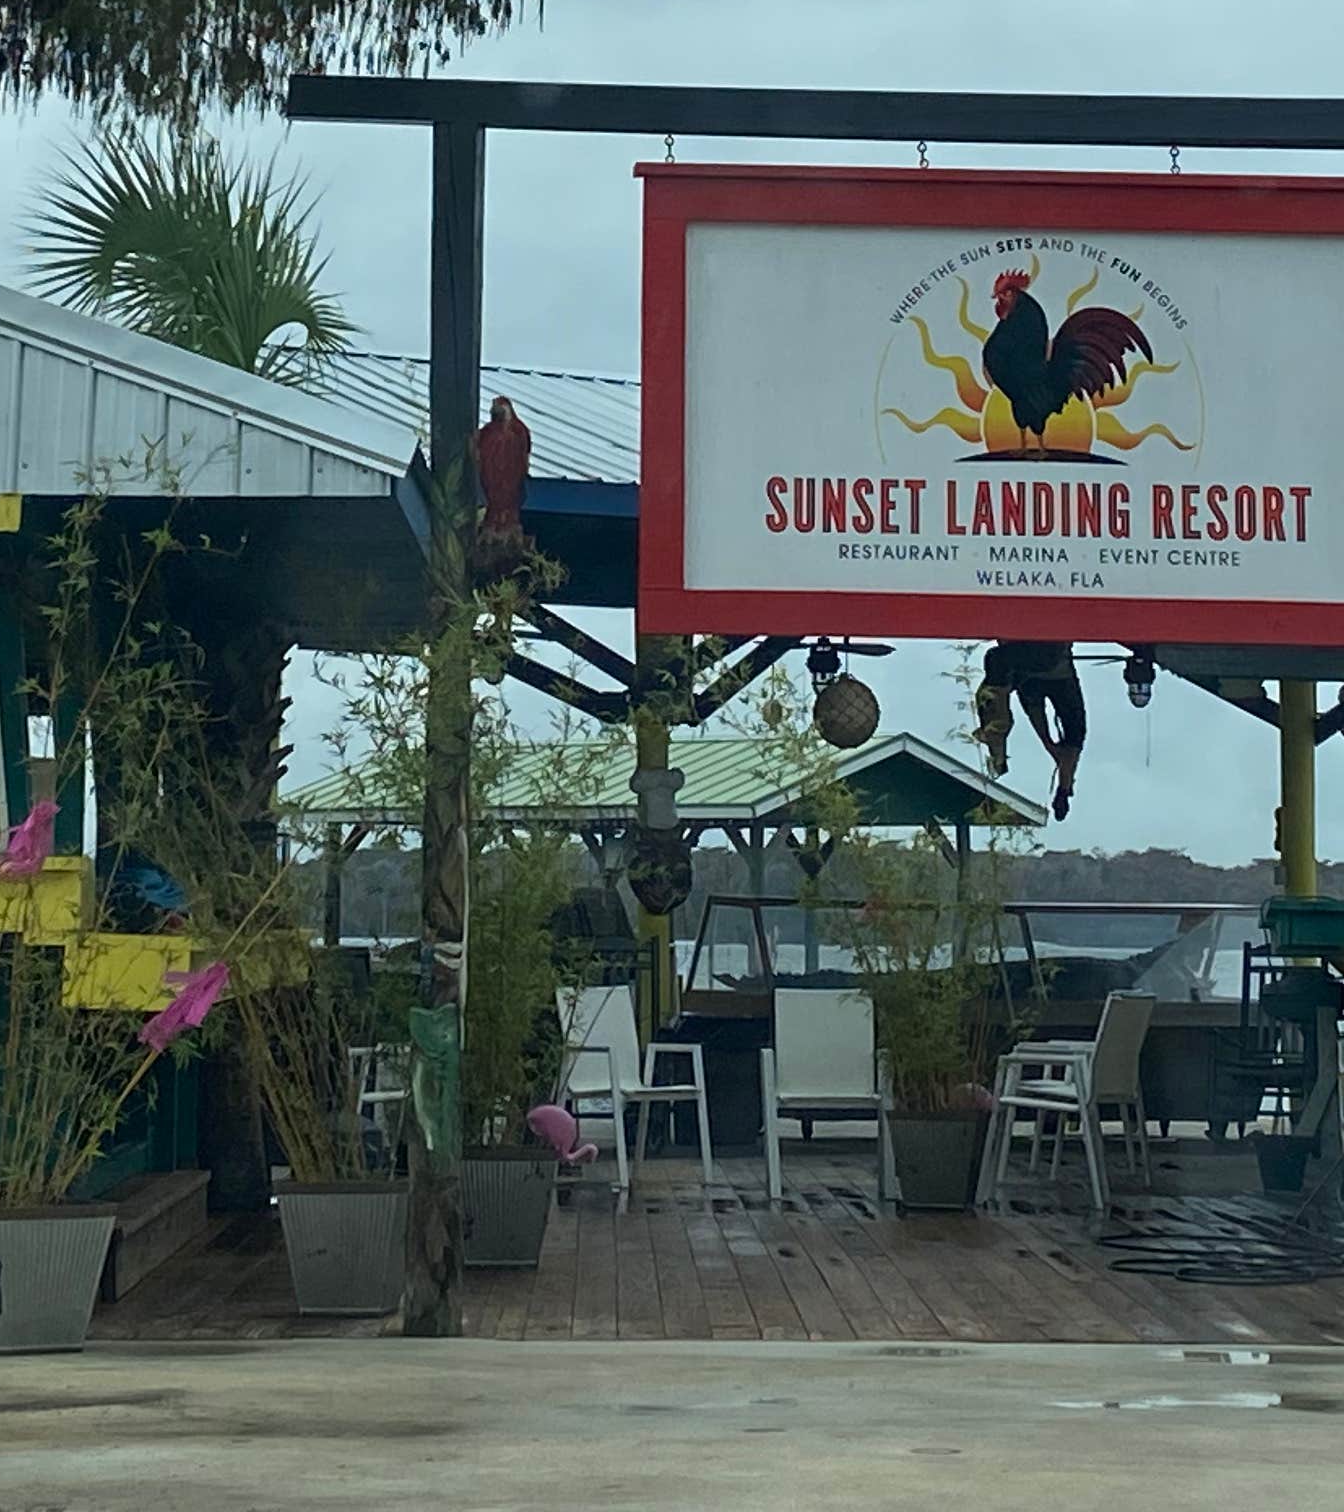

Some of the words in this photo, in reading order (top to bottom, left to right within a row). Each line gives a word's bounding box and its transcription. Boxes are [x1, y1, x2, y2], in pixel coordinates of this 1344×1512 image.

[889, 277, 931, 325] WHERE
[930, 260, 958, 284] THE
[960, 245, 991, 267] SUN
[996, 237, 1033, 254] SETS
[1038, 238, 1074, 254] AND
[1080, 242, 1107, 265] THE
[1109, 256, 1142, 284] FUN
[1141, 279, 1189, 332] BEGINS
[765, 476, 926, 535] SUNSET
[947, 480, 1131, 539] LANDING
[1152, 483, 1313, 543] RESORT
[838, 543, 959, 562] RESTAURANT
[989, 545, 1069, 564] MARINA
[1099, 548, 1162, 567] EVENT
[1167, 549, 1241, 568] CENTRE
[1071, 571, 1105, 589] FLA
